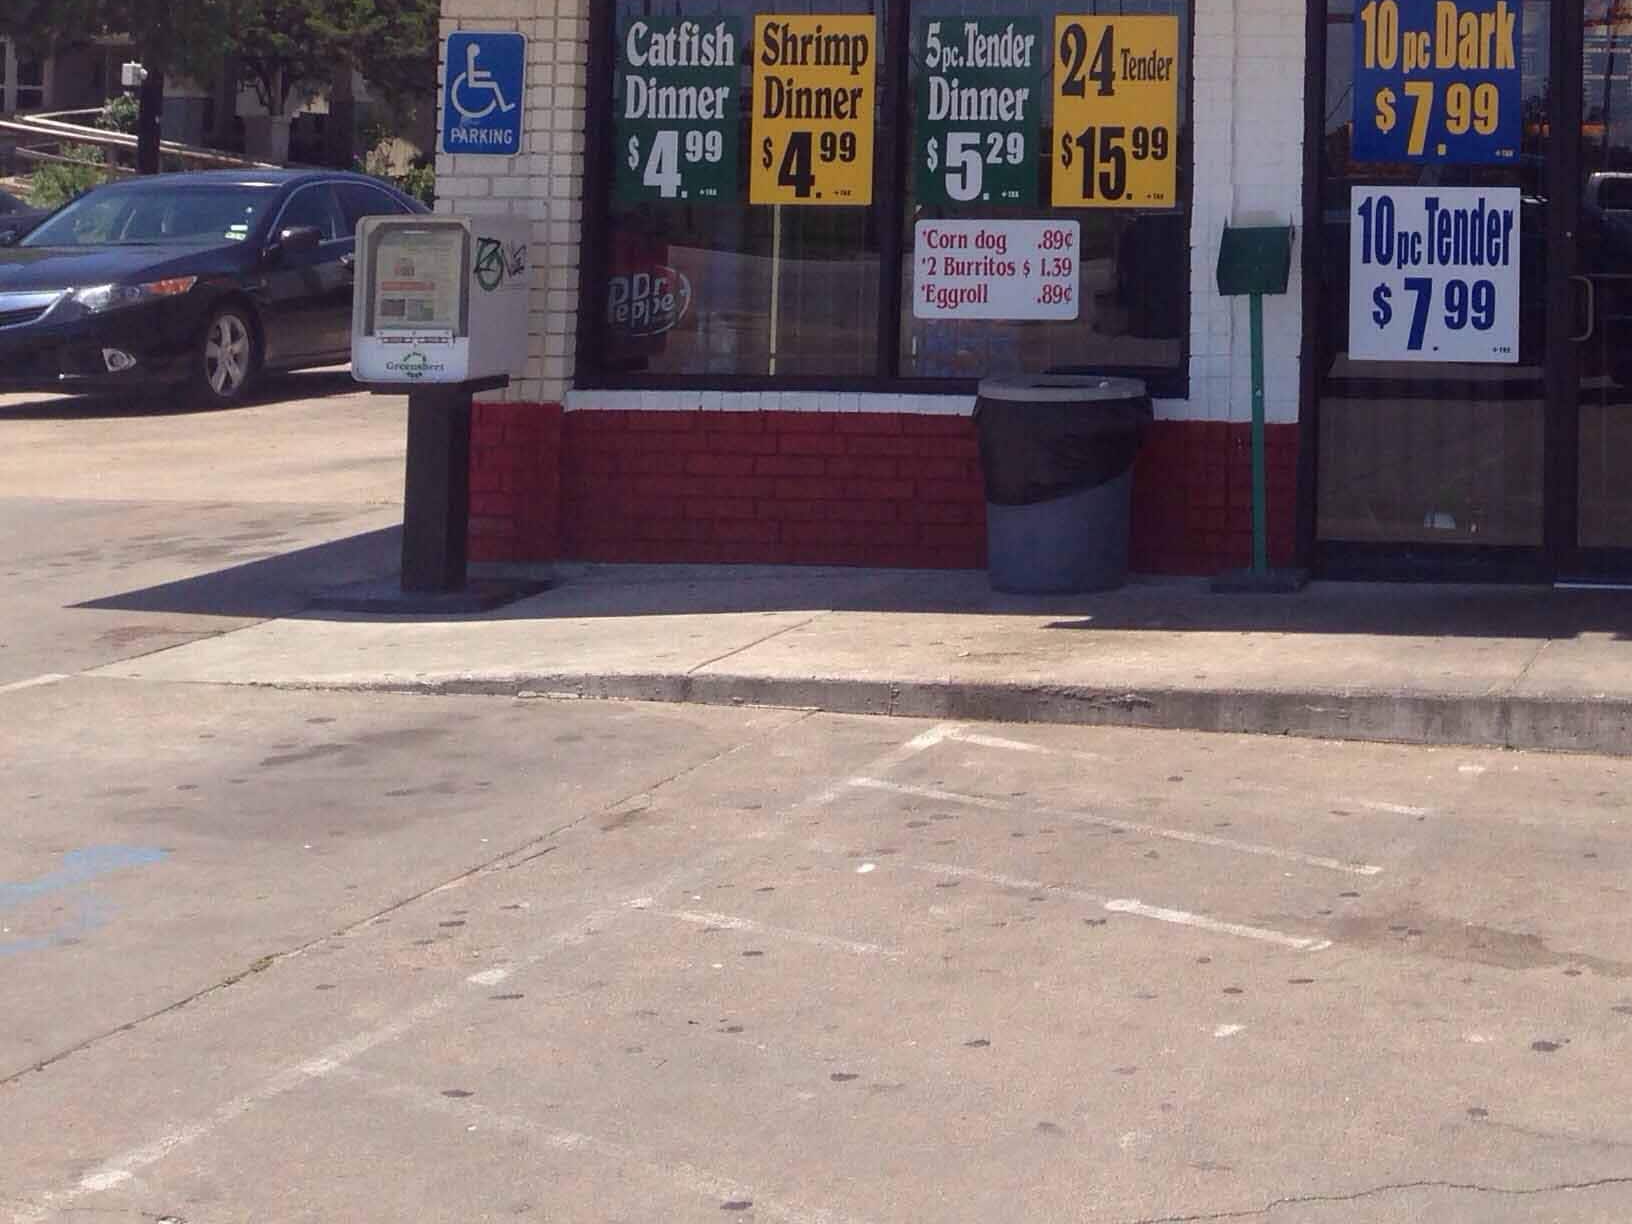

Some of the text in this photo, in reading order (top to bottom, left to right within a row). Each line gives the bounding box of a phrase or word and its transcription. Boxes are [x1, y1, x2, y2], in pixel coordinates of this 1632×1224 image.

[627, 21, 735, 67] Catfish
[761, 22, 869, 74] Shrimp
[964, 22, 1036, 68] Tender
[1060, 24, 1173, 99] 24 Tender
[1361, 0, 1398, 70] 10
[1402, 29, 1430, 73] pc
[1436, 0, 1516, 71] Dark
[625, 75, 731, 121] Dinner
[763, 75, 864, 121] Dinner
[928, 77, 1030, 122] Dinner
[1375, 81, 1499, 156] $7.99
[450, 127, 513, 145] PARKING
[628, 130, 724, 199] $4.99
[763, 131, 858, 200] $4.99
[927, 131, 1025, 202] $5.29
[1061, 126, 1170, 201] $15.99
[975, 230, 1008, 252] dog
[1037, 231, 1073, 250] .89¢
[1357, 195, 1514, 270] 10 pc Tender
[943, 257, 1016, 276] Burritos
[1037, 285, 1073, 304] .89¢
[1372, 277, 1496, 351] $7.99
